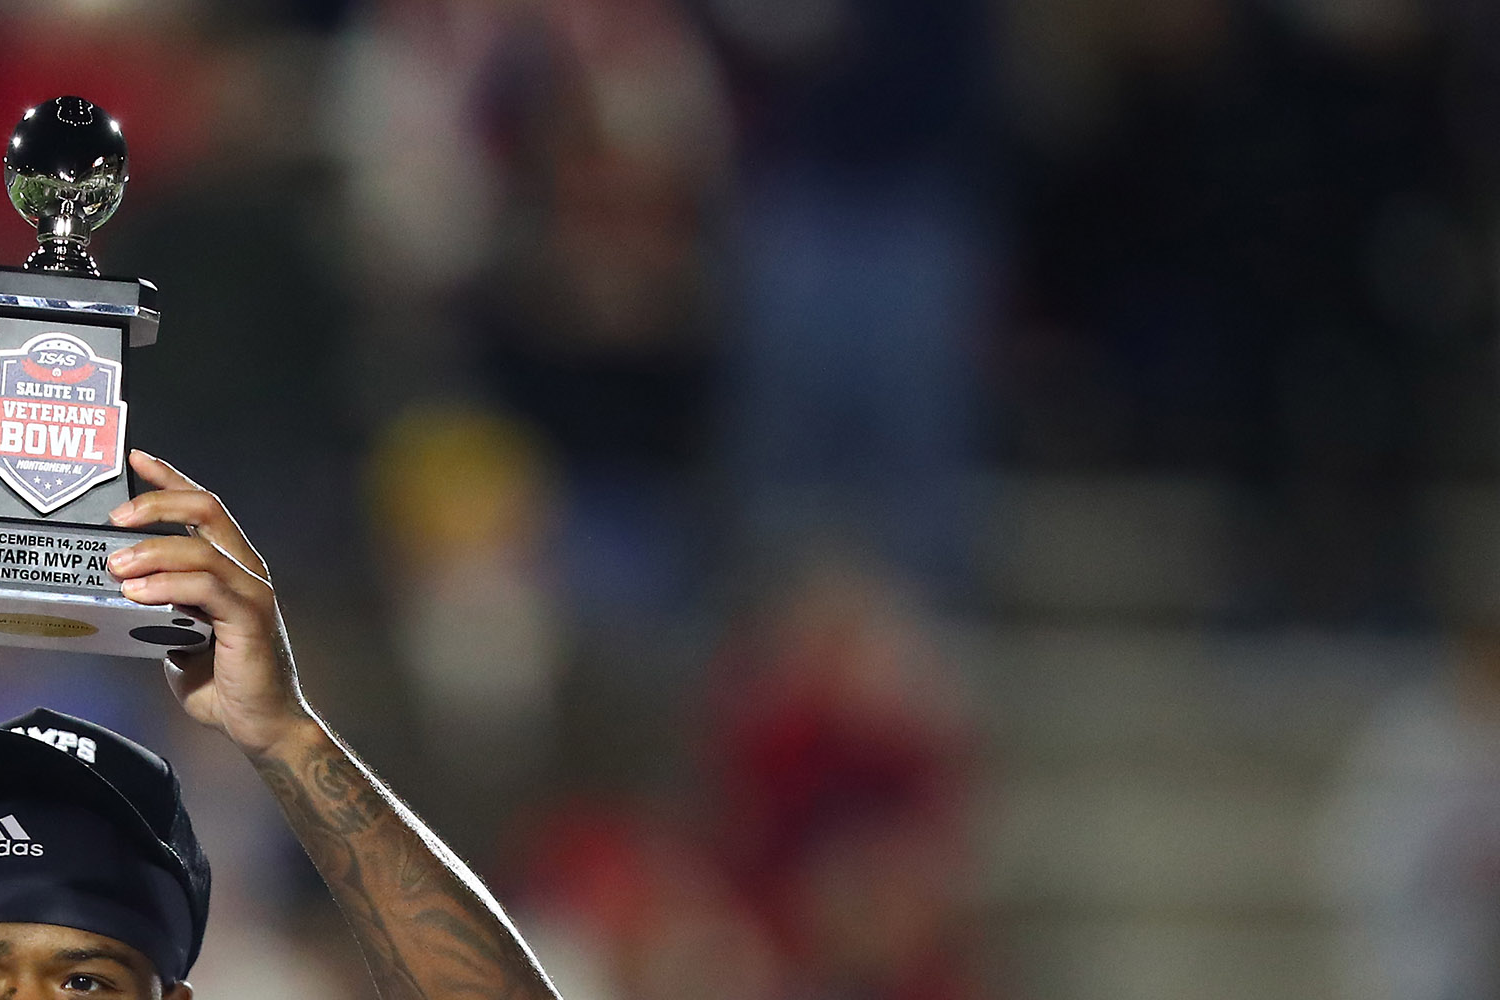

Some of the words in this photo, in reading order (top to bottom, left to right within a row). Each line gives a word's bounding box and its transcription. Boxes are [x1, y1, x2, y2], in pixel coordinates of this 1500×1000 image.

[16, 381, 72, 400] SALUTE
[76, 386, 96, 401] TO
[2, 400, 107, 426] VETERANS
[0, 420, 103, 460] BOWL
[57, 539, 74, 552] 14,
[76, 539, 107, 552] 2024
[44, 552, 83, 571] MVP
[86, 575, 104, 587] AL
